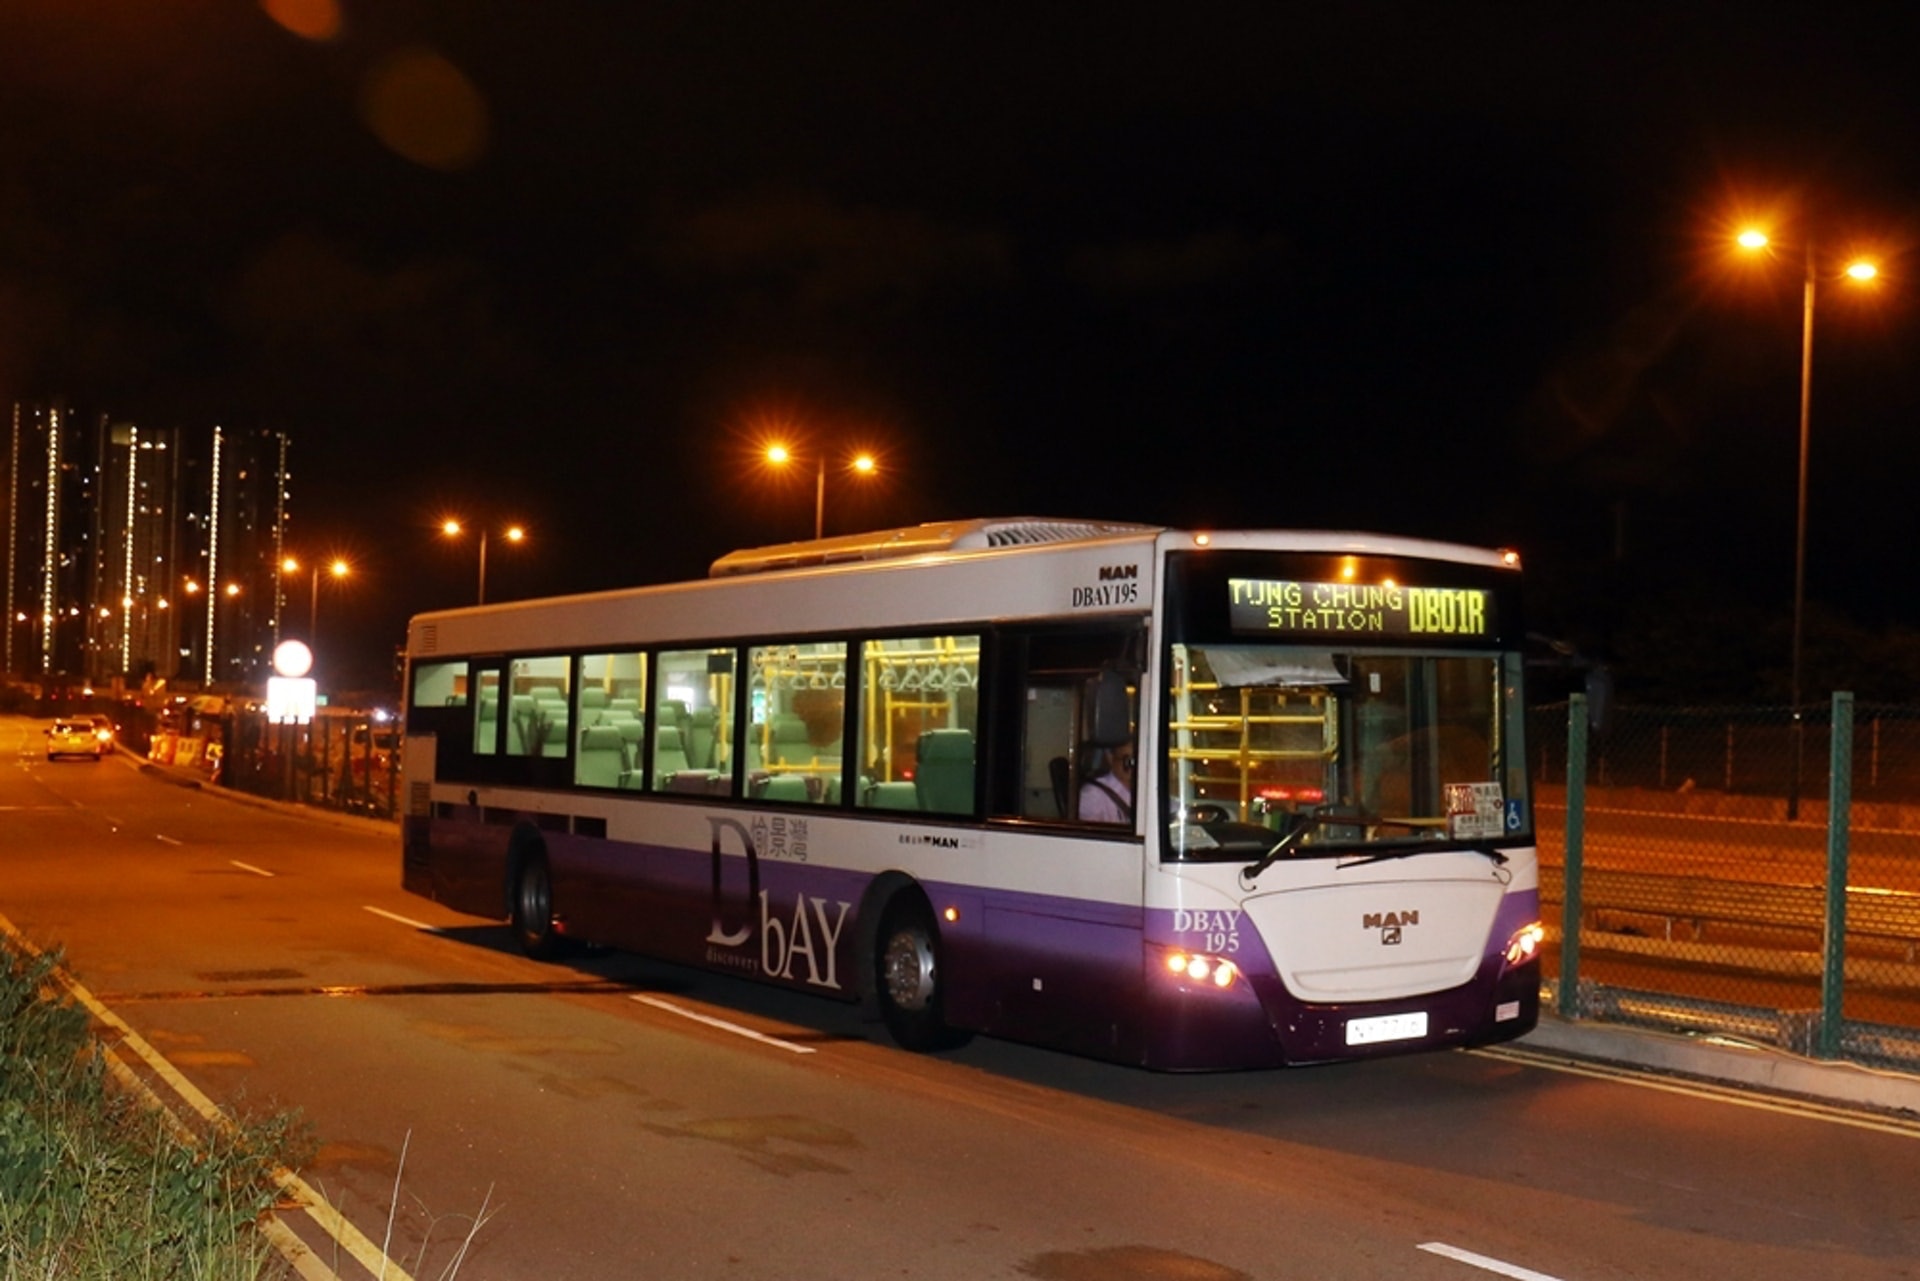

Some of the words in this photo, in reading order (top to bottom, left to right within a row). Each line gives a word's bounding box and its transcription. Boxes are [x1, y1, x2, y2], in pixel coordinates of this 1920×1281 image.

[1099, 565, 1138, 580] MAN
[1228, 579, 1302, 606] TUNG
[1313, 584, 1403, 610] CHUNG
[1267, 607, 1383, 631] STATION
[1173, 911, 1241, 932] DBAY
[1363, 910, 1419, 929] MAN
[1206, 932, 1240, 952] 195
